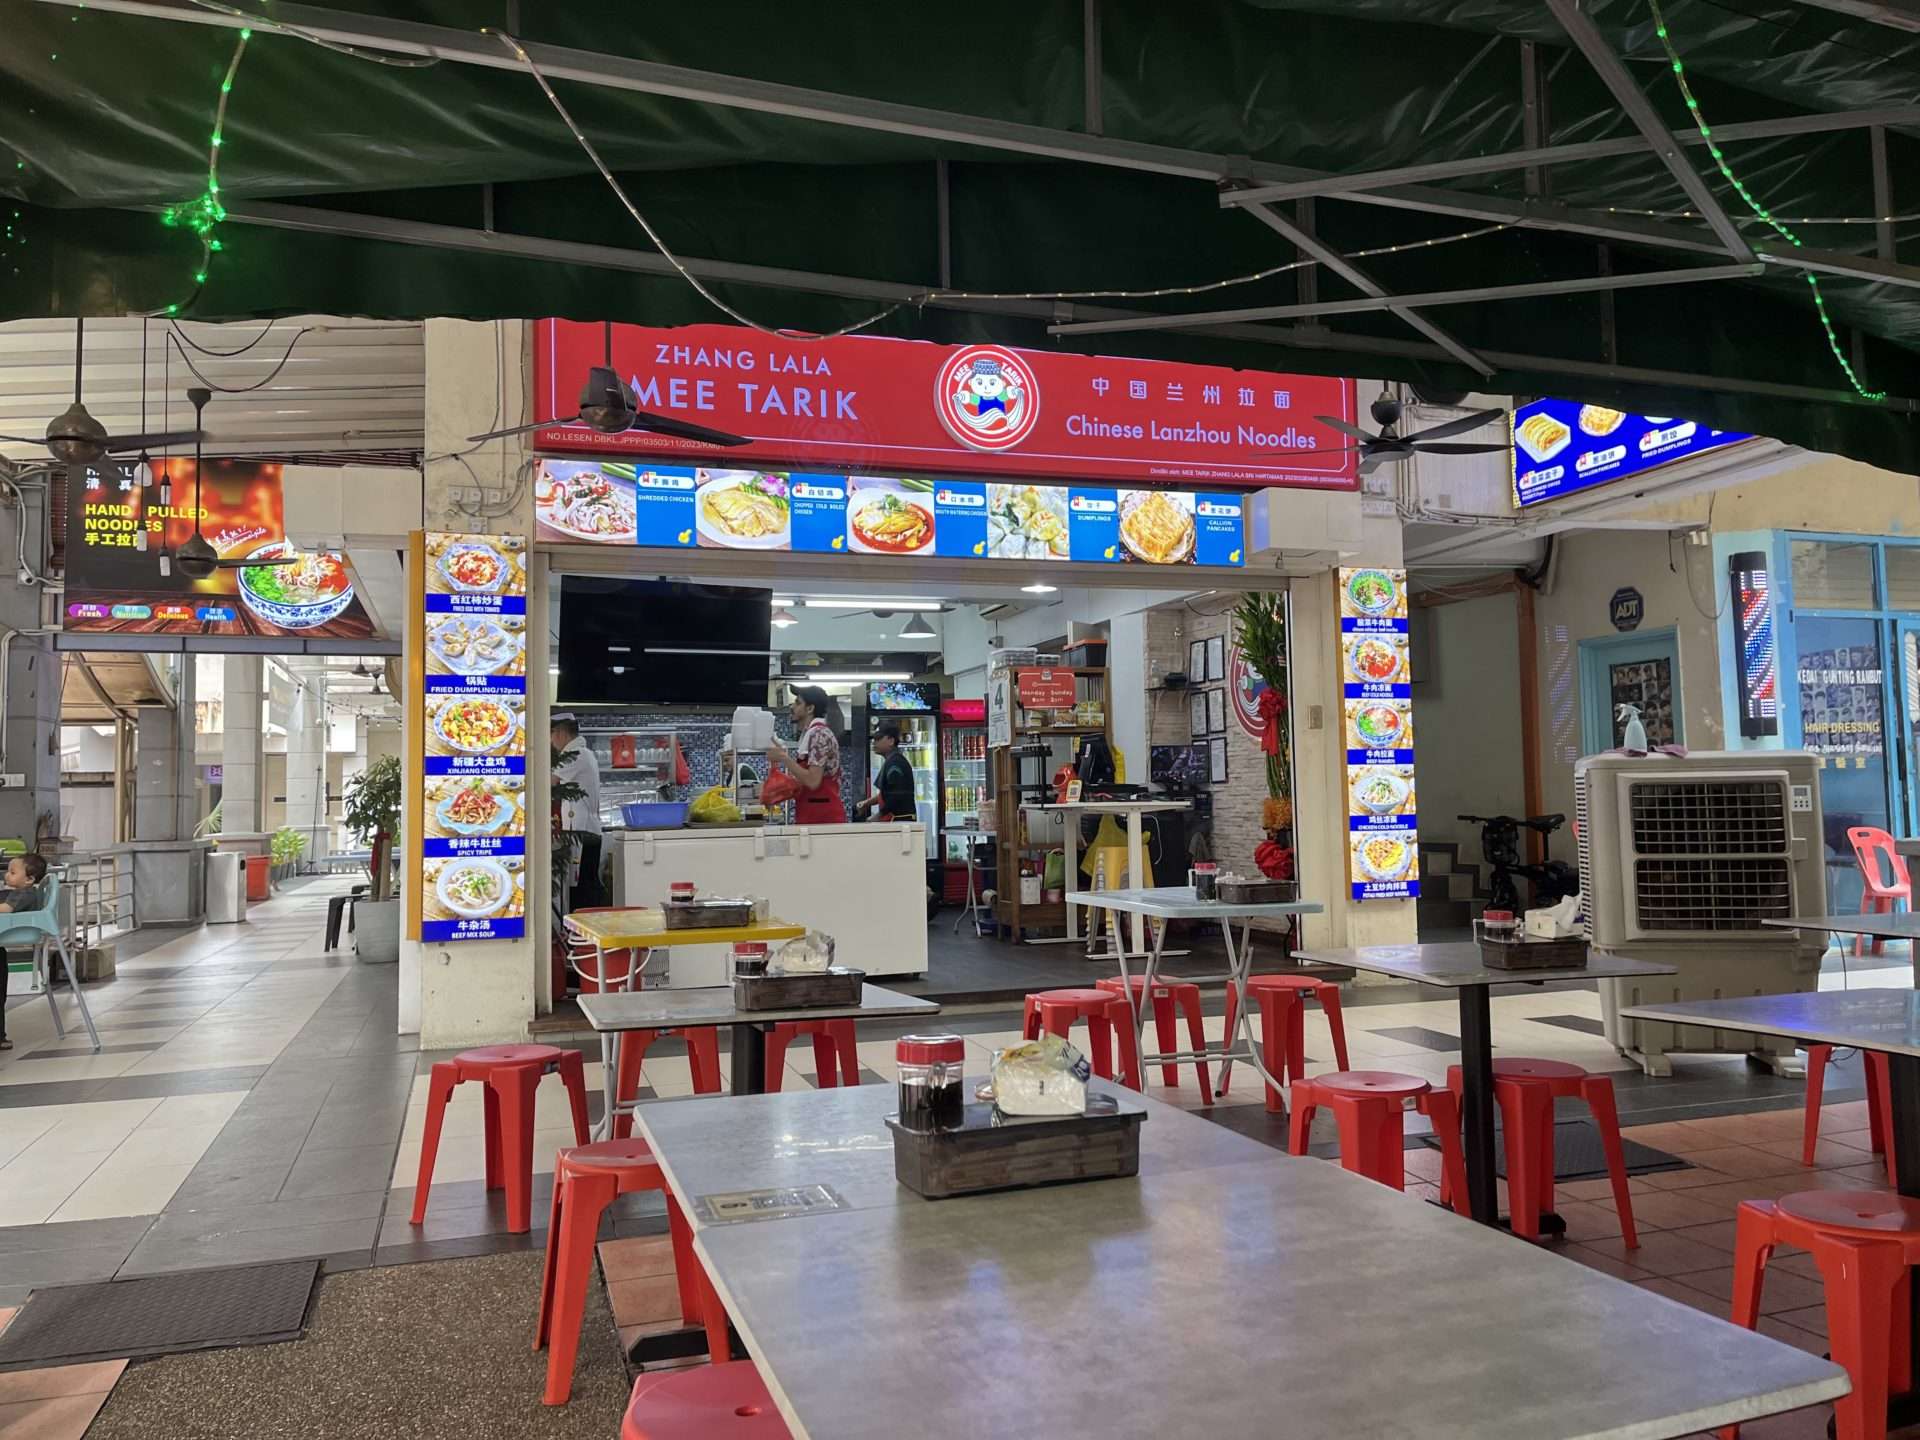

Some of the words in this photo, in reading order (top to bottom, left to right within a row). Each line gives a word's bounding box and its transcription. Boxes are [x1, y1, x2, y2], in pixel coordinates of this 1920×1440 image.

[656, 344, 755, 369] ZHANG
[770, 353, 832, 376] LALA
[954, 364, 970, 381] MEE
[630, 374, 715, 410] MEE
[739, 384, 859, 420] TARIK
[1092, 377, 1290, 409] 中国兰州拉面
[1066, 415, 1143, 440] Chinese
[1151, 420, 1231, 445] Lanzhou
[1238, 425, 1316, 449] Noodles
[85, 504, 132, 516] HAND
[148, 506, 208, 519] PULLED
[1616, 600, 1638, 619] ADT
[1797, 670, 1817, 684] KEDAI
[1823, 670, 1854, 684] GUNTING
[1856, 670, 1882, 684] RAMBUT
[995, 683, 1003, 710] 4
[1805, 723, 1829, 733] HAIR
[1831, 722, 1880, 733] DRESSING
